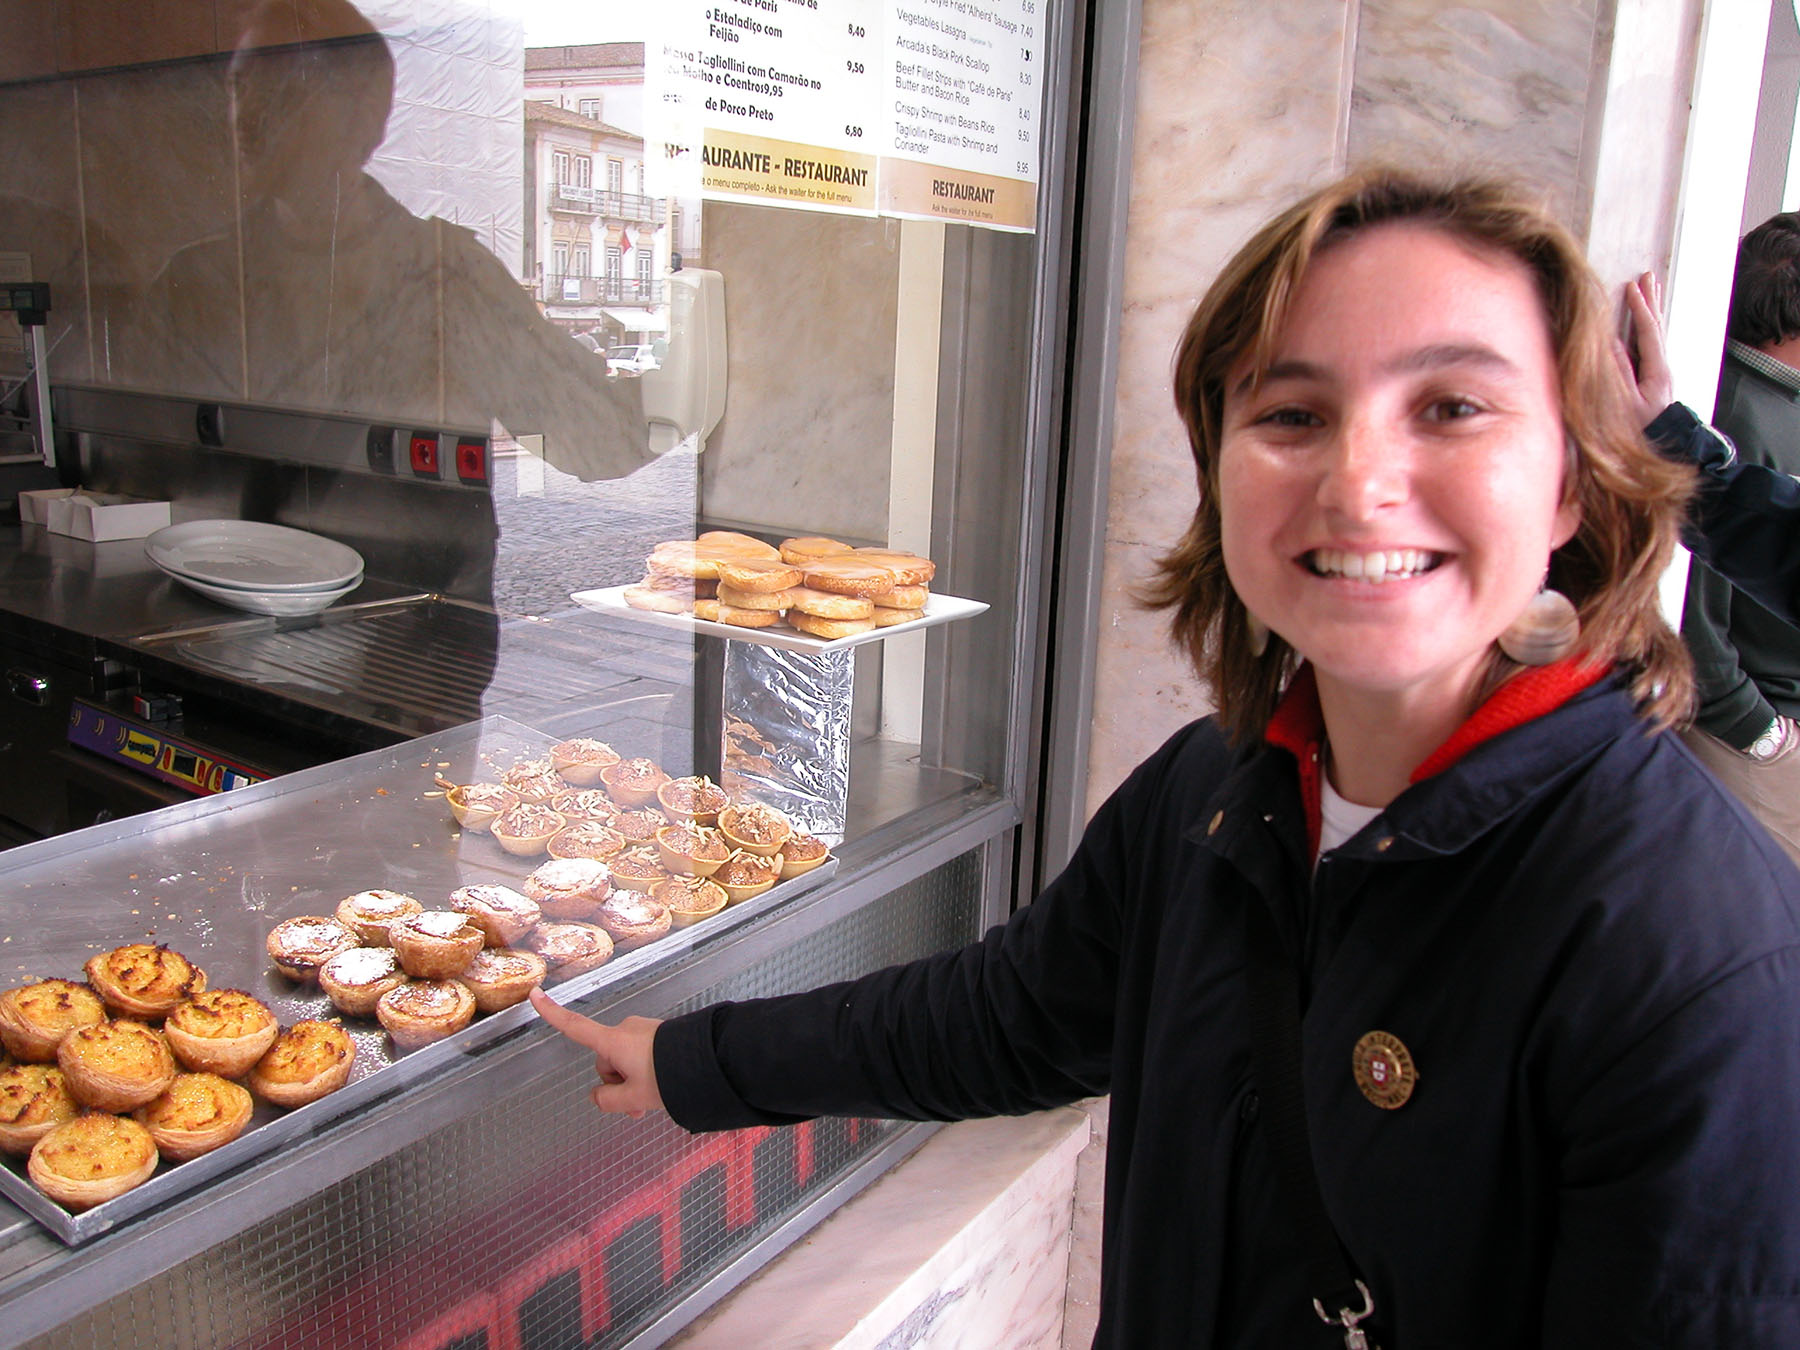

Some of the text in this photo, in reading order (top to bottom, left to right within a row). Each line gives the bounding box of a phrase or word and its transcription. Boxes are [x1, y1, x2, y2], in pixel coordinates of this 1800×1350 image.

[709, 24, 739, 43] Feijão
[714, 8, 762, 34] Estaladiço
[764, 25, 783, 38] com
[848, 24, 865, 37] 8,40
[896, 8, 967, 40] Vegetables Lasagna
[994, 13, 1018, 34] Sausage
[1020, 24, 1033, 38] 7,40
[847, 60, 864, 74] 9,50
[896, 35, 990, 74] Arcada's Black Pork Scallop
[698, 51, 745, 73] Tagliollini
[747, 65, 766, 78] com
[768, 67, 809, 87] Camarão
[811, 80, 822, 90] no
[715, 74, 721, 85] e
[895, 60, 915, 76] Beef
[935, 70, 952, 87] Strips
[953, 78, 966, 90] with
[986, 86, 996, 98] de
[895, 76, 970, 106] Butter and Bacon Rice
[705, 97, 774, 121] de Porco Preto
[895, 100, 995, 134] Crispy Shrimp with Beans Rice
[894, 137, 929, 154] Coriander
[928, 128, 946, 144] Pasta
[947, 135, 960, 147] with
[961, 136, 985, 152] Shrimp
[985, 143, 998, 154] and
[784, 158, 868, 187] RESTAURANT
[713, 178, 731, 188] menu
[732, 180, 761, 193] completo
[765, 183, 777, 193] Ask
[778, 185, 788, 195] the
[789, 187, 807, 197] waiter
[808, 188, 816, 198] for
[817, 190, 826, 200] the
[827, 191, 835, 200] full
[836, 193, 852, 203] menu
[932, 179, 995, 204] RESTAURANT
[932, 203, 940, 211] Ask
